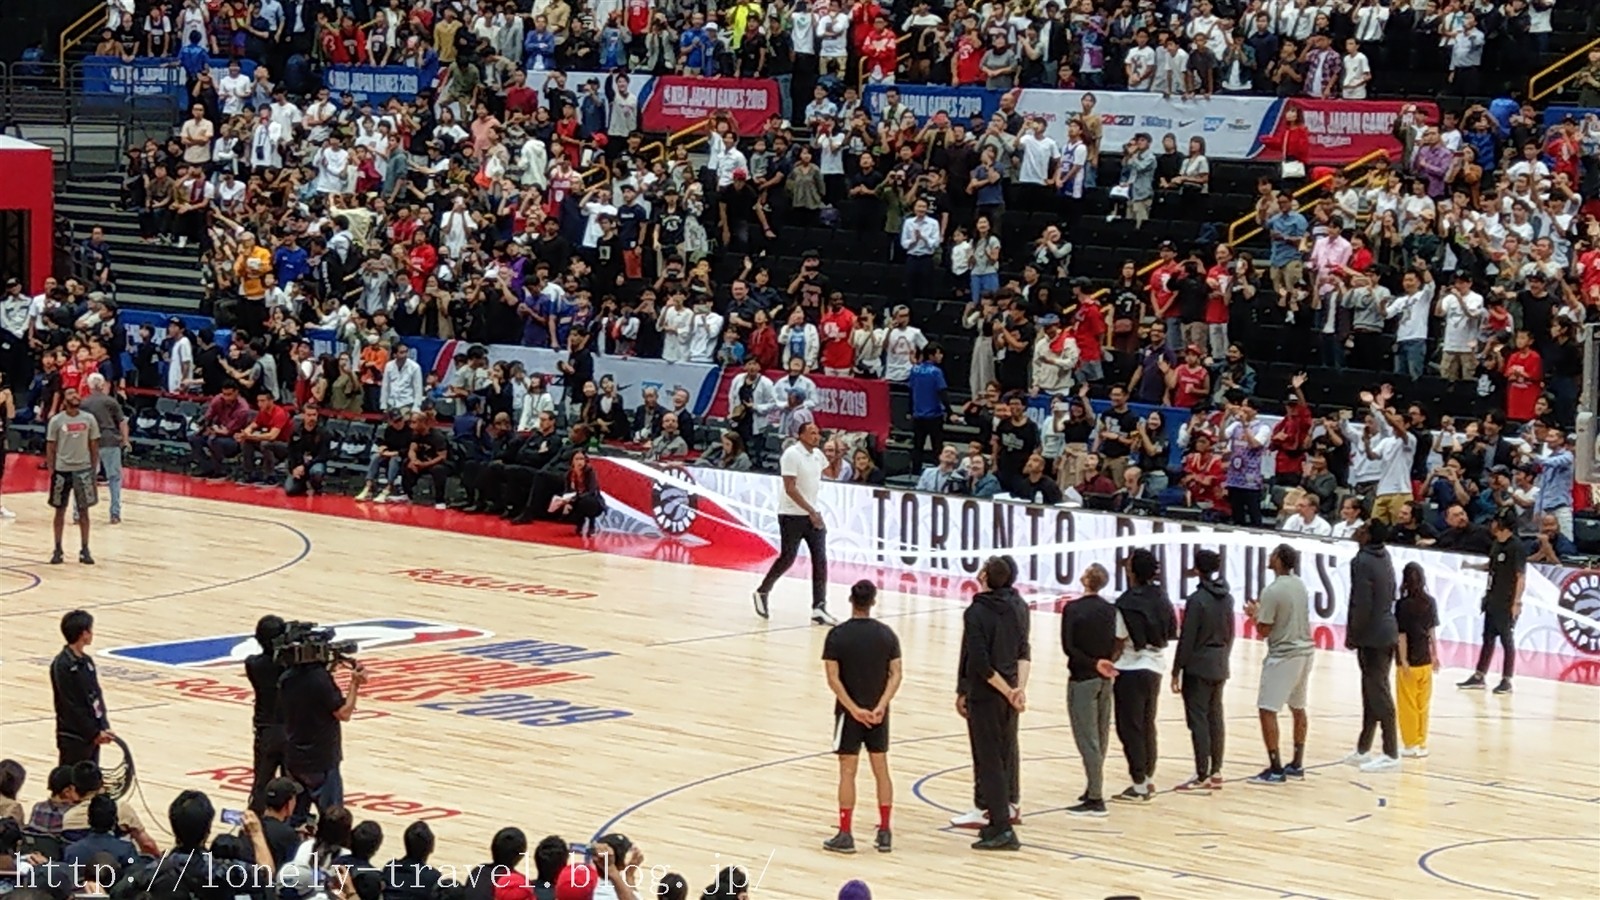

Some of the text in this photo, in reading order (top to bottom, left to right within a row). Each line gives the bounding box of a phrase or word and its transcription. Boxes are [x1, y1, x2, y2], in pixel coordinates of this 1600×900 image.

[671, 86, 767, 110] NBA JAPAN GAMES 2019
[1327, 111, 1361, 134] JAPAN
[839, 389, 868, 417] 2019
[872, 487, 1077, 586] TORONTO
[442, 639, 622, 667] NBA
[415, 693, 635, 727] 2019
